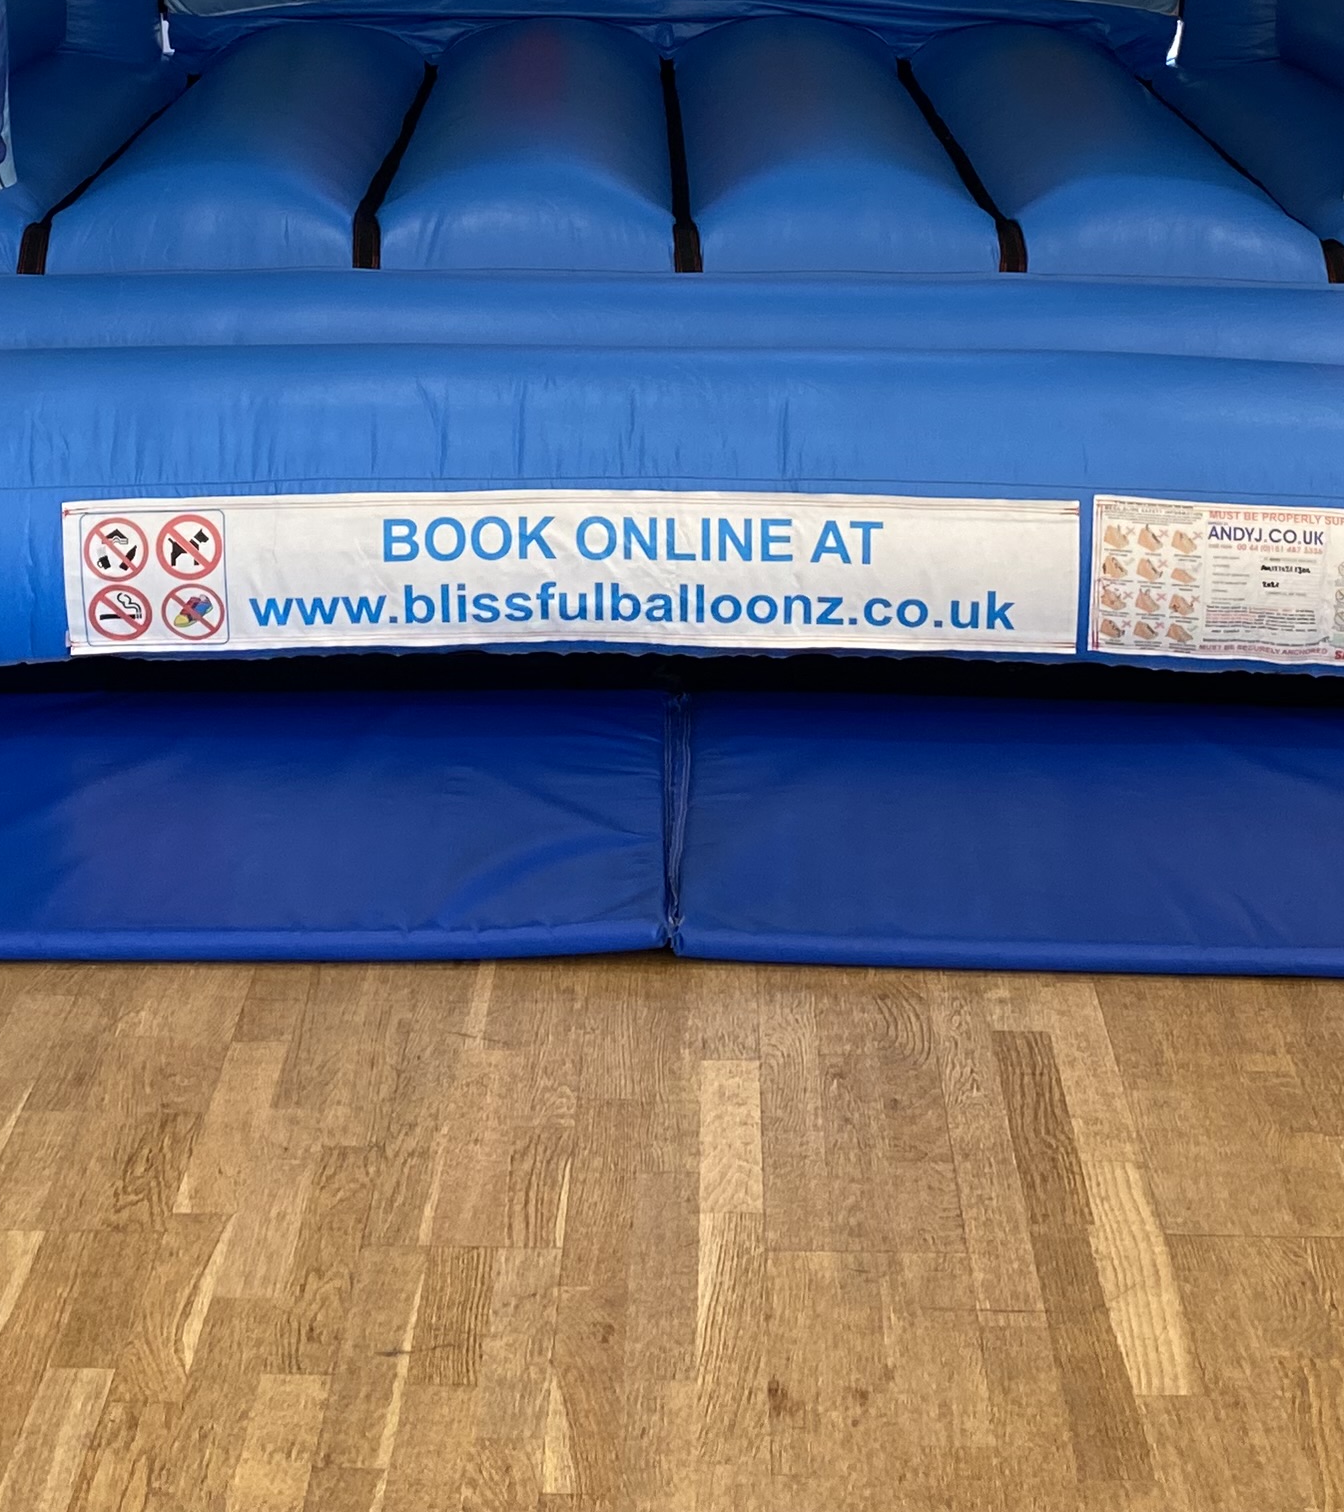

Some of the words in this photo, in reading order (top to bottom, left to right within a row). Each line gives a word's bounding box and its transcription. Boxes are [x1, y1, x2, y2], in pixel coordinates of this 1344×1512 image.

[1209, 510, 1241, 520] MUST
[1244, 512, 1259, 521] BE
[1262, 513, 1322, 524] PROPERLY
[384, 517, 554, 562] BOOK
[576, 517, 792, 562] ONLINE
[812, 521, 883, 564] AT
[1207, 526, 1324, 546] ANDYJ.CO.UK
[250, 582, 1015, 630] www.blissfulballoonz.co.uk
[1281, 647, 1328, 655] ANCHORED
